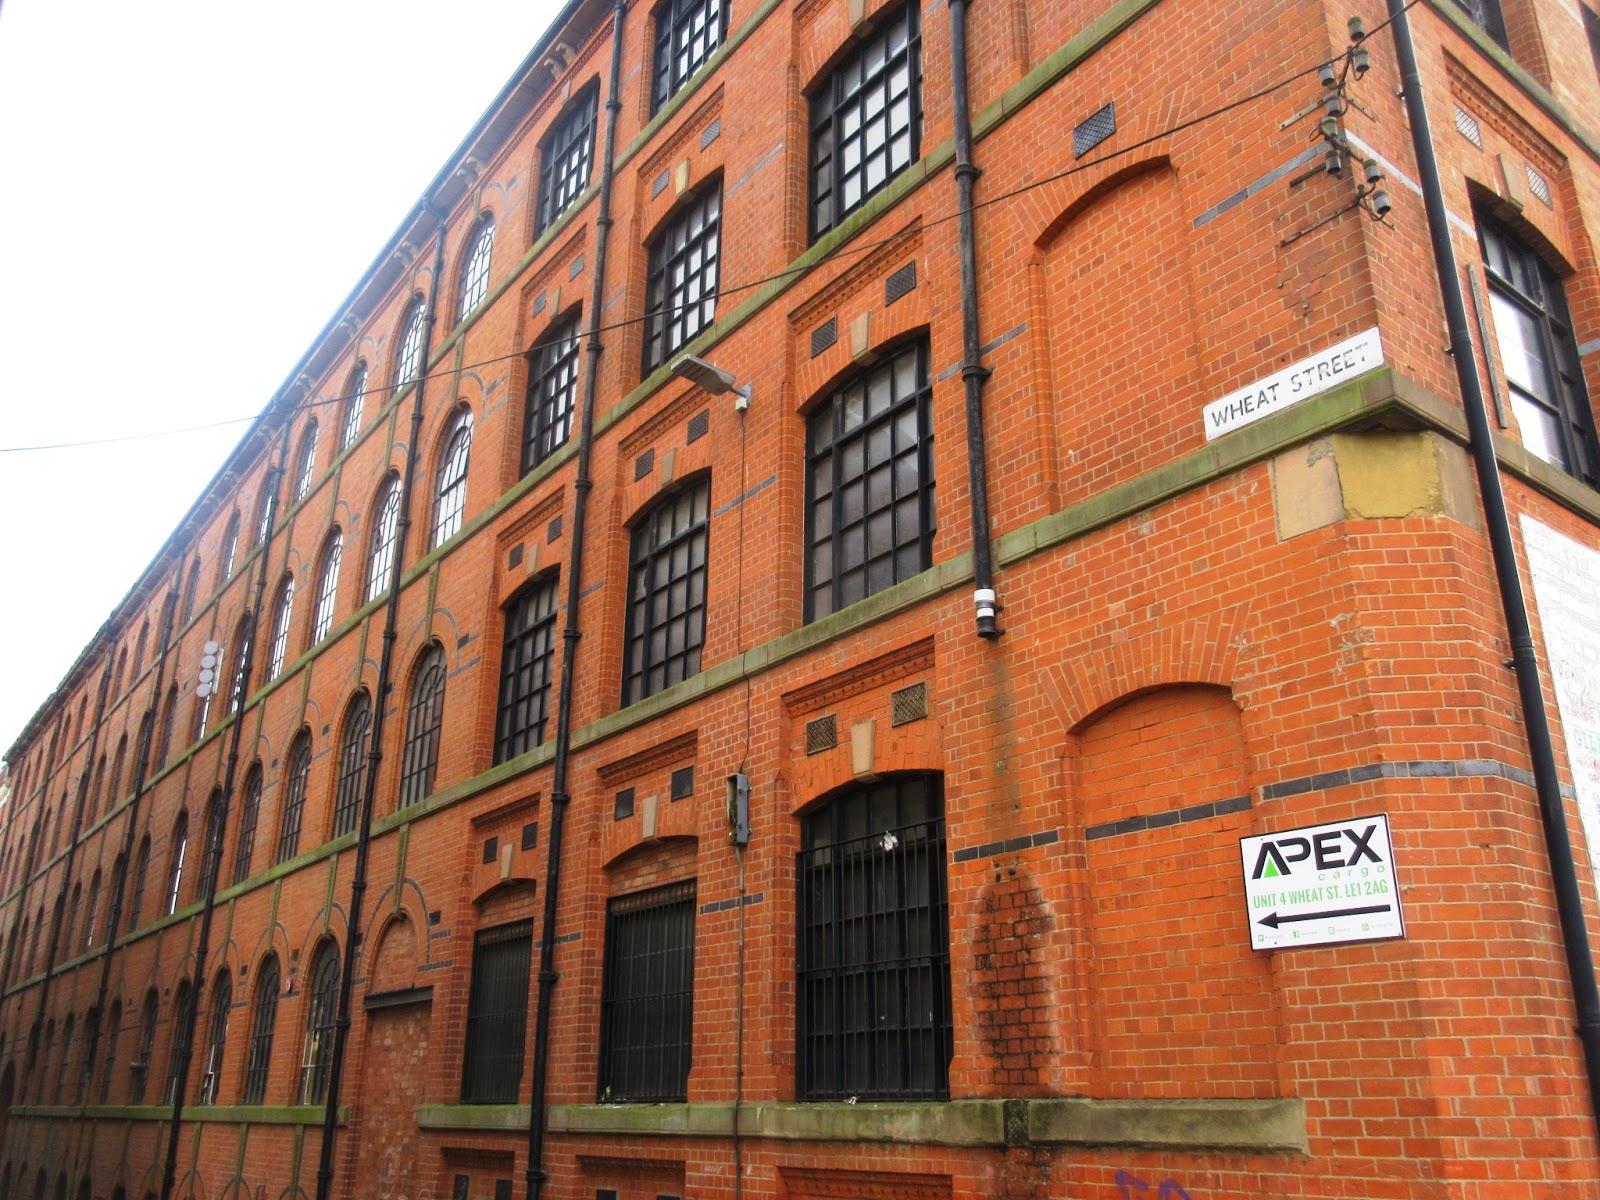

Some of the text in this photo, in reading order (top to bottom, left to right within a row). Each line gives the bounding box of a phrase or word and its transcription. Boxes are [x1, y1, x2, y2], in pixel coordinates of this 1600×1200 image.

[1211, 341, 1368, 428] WHEAT STREET
[1251, 824, 1383, 880] APEX
[1318, 864, 1386, 881] cargo
[1253, 879, 1389, 909] UNIT 4 WHEAT ST. LE1 2AG
